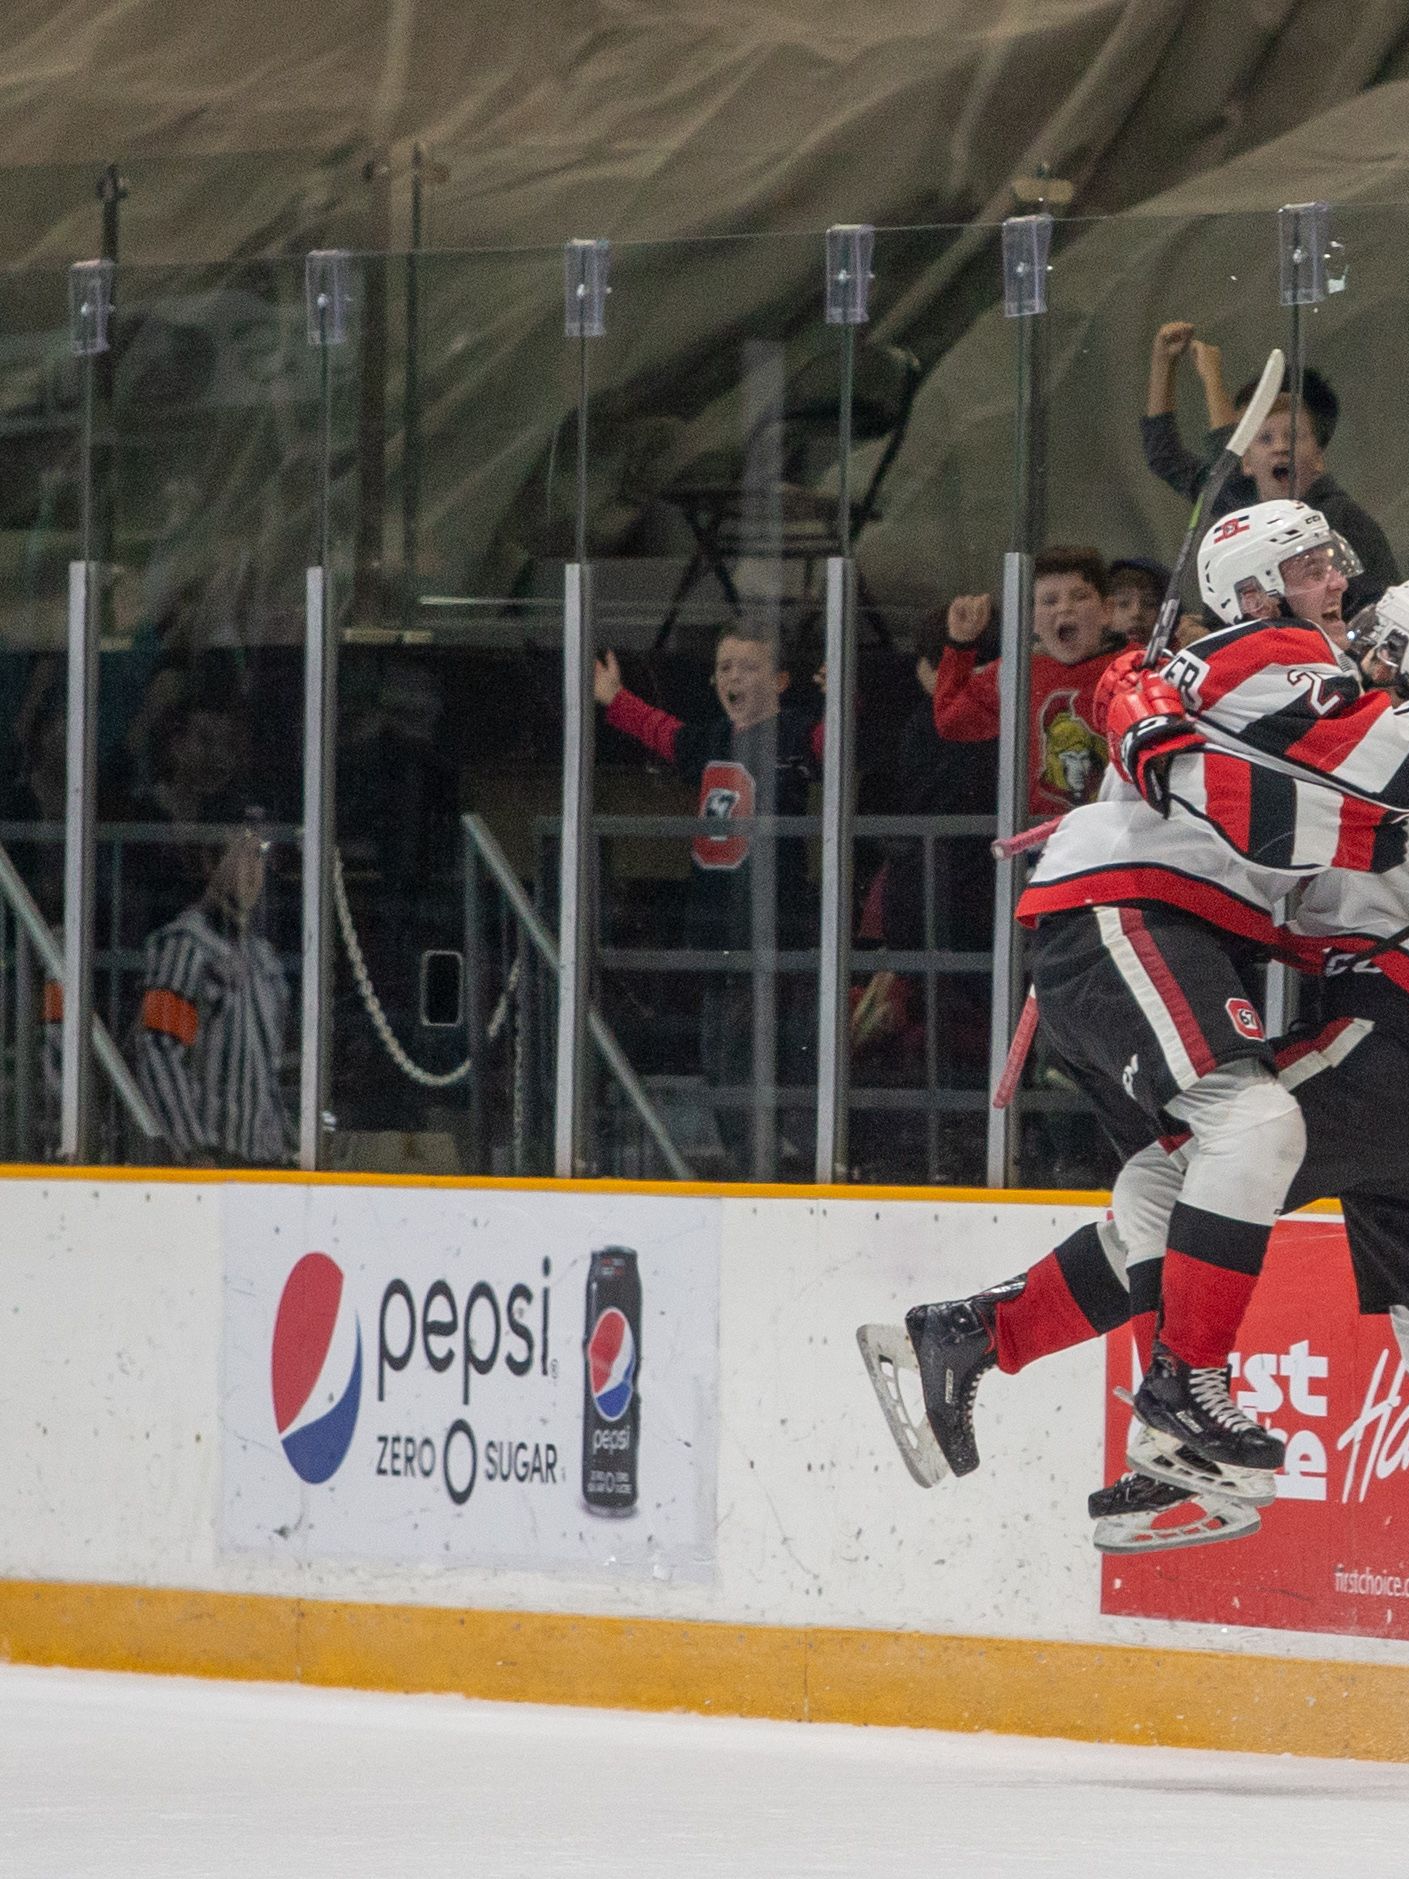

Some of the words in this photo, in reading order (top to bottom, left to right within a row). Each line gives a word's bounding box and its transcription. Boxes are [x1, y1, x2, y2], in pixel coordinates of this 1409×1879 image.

[378, 1255, 551, 1406] pepsi
[376, 1436, 436, 1478] ZERO
[485, 1440, 558, 1484] SUGAR
[592, 1424, 631, 1455] pepsi
